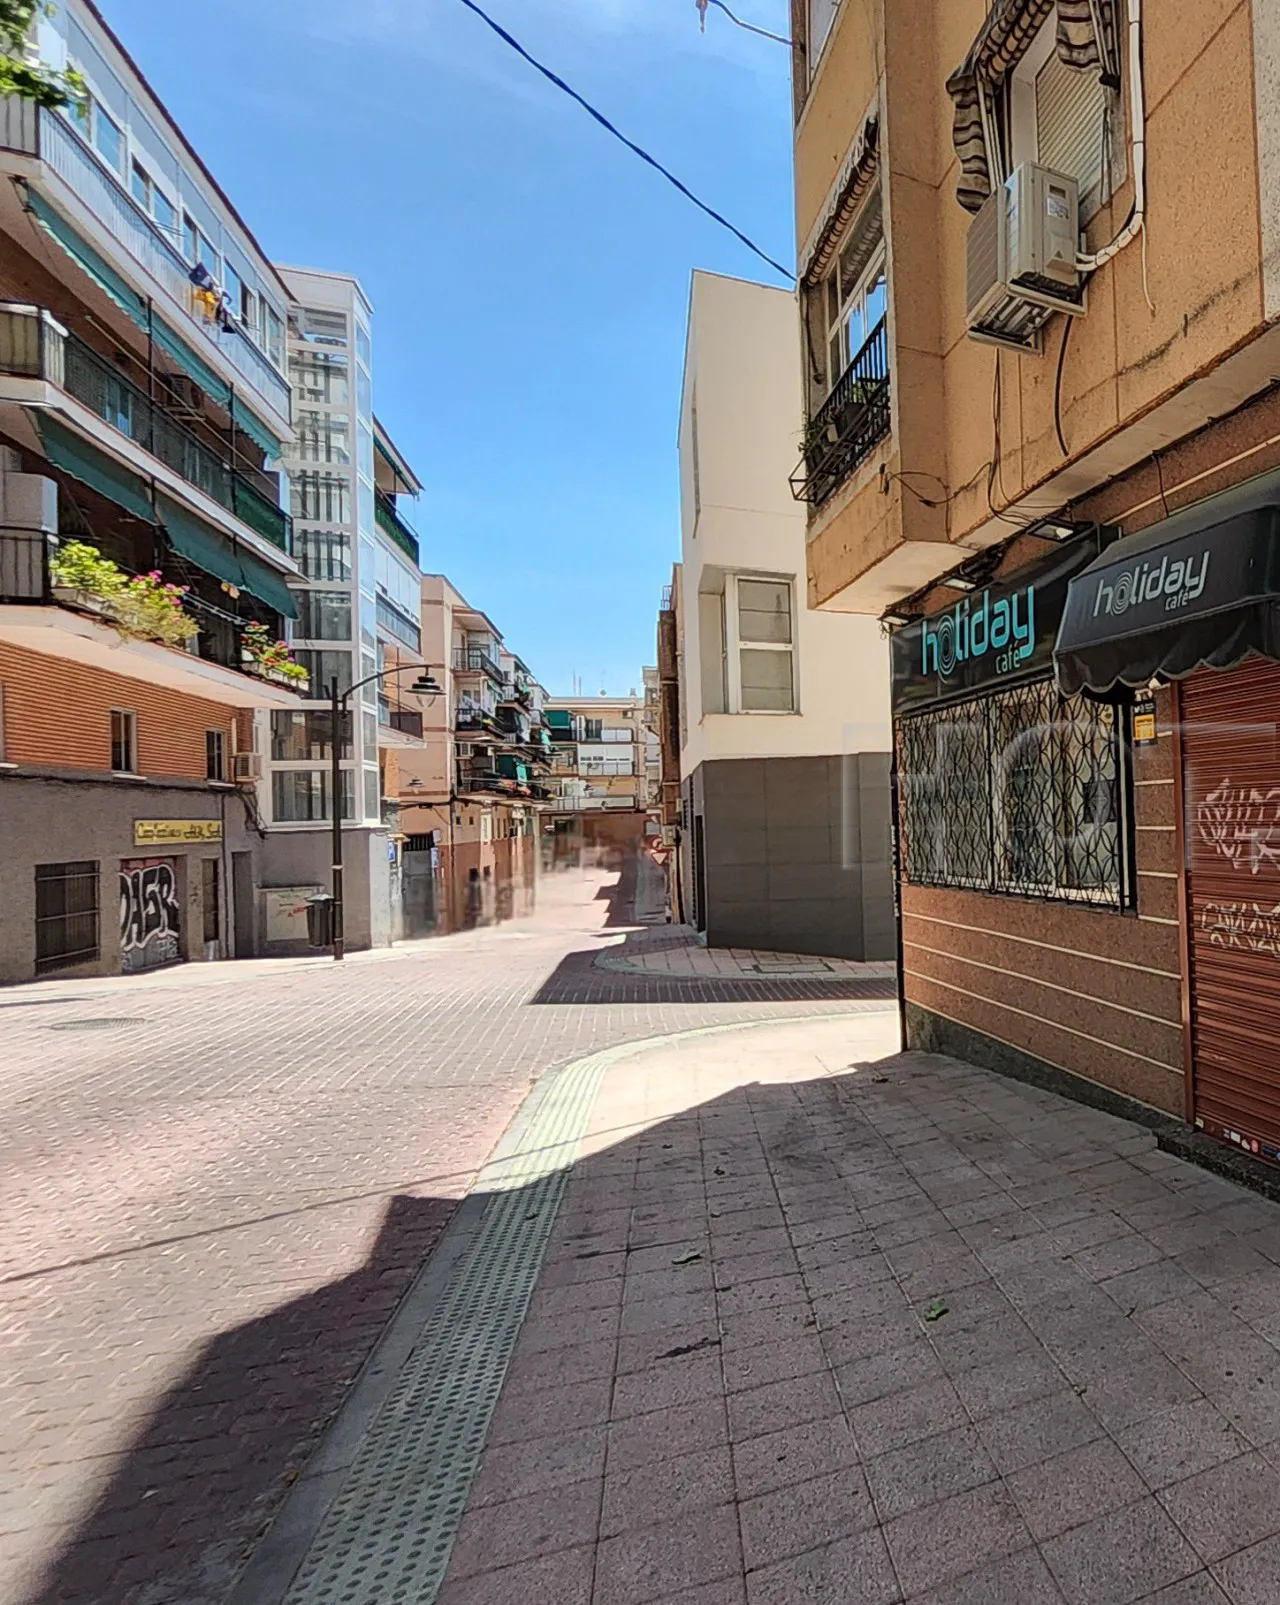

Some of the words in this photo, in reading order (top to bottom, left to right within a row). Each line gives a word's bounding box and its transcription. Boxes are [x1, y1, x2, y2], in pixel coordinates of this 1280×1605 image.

[1093, 551, 1210, 616] holiday
[1164, 586, 1188, 611] café
[922, 585, 1035, 683] holiday
[995, 640, 1021, 674] café
